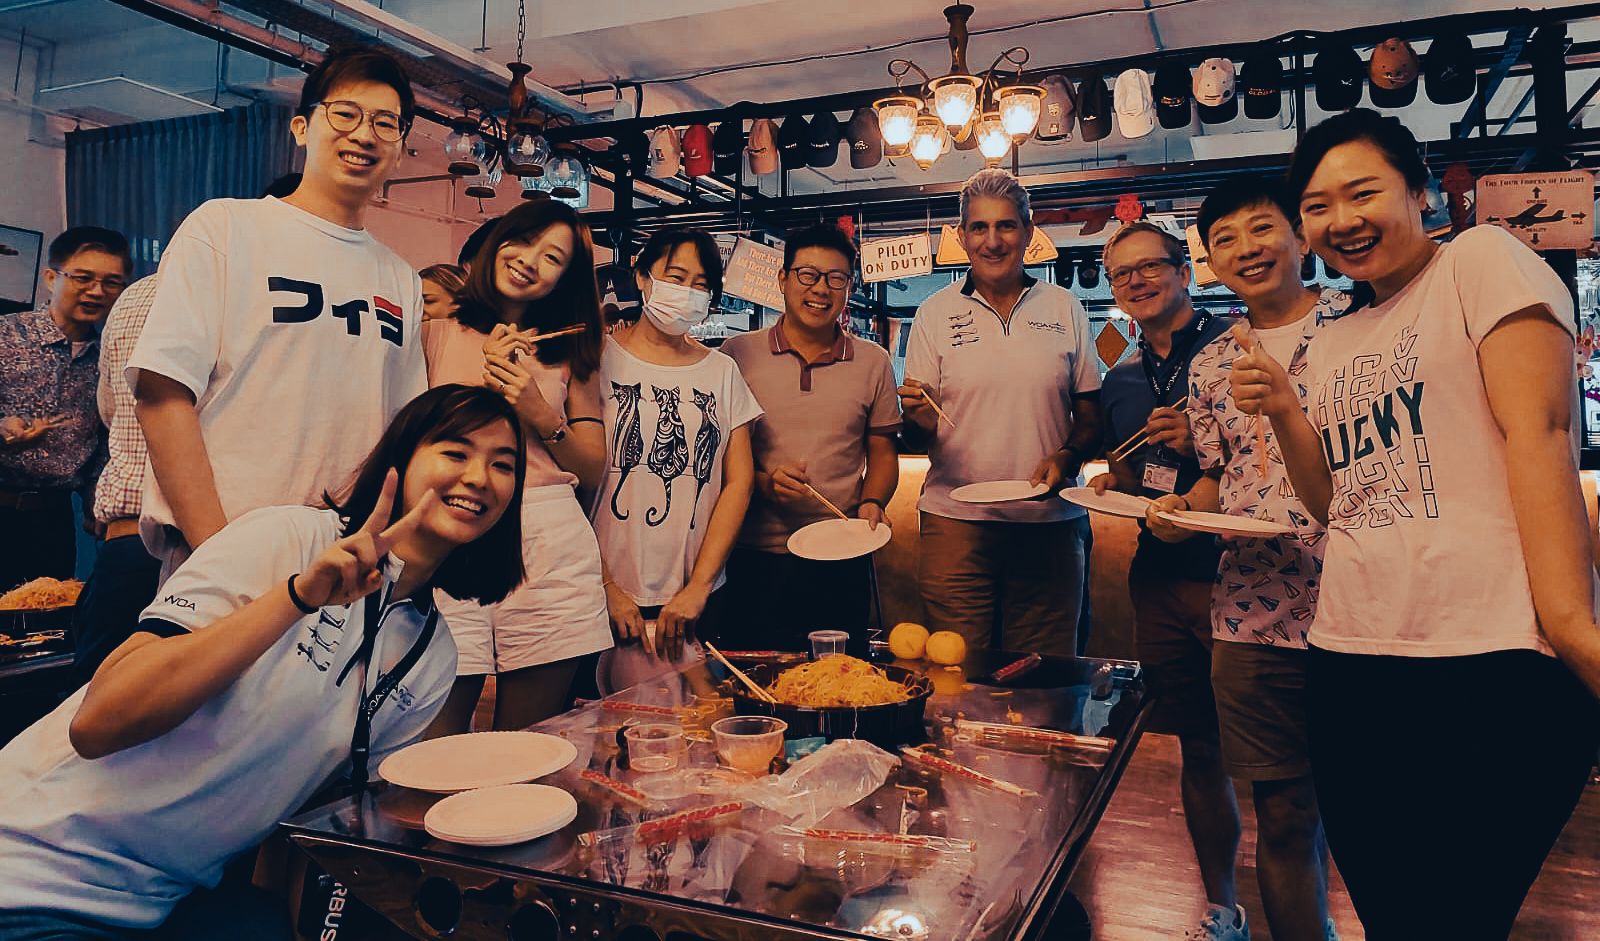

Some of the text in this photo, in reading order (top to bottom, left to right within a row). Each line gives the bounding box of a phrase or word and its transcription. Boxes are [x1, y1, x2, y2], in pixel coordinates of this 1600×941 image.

[866, 255, 928, 275] ON DUTY
[878, 243, 913, 259] PILOT
[268, 276, 403, 347] フィラ
[1322, 381, 1425, 473] UCKY
[164, 594, 196, 612] WOA
[320, 882, 348, 941] RBUS
